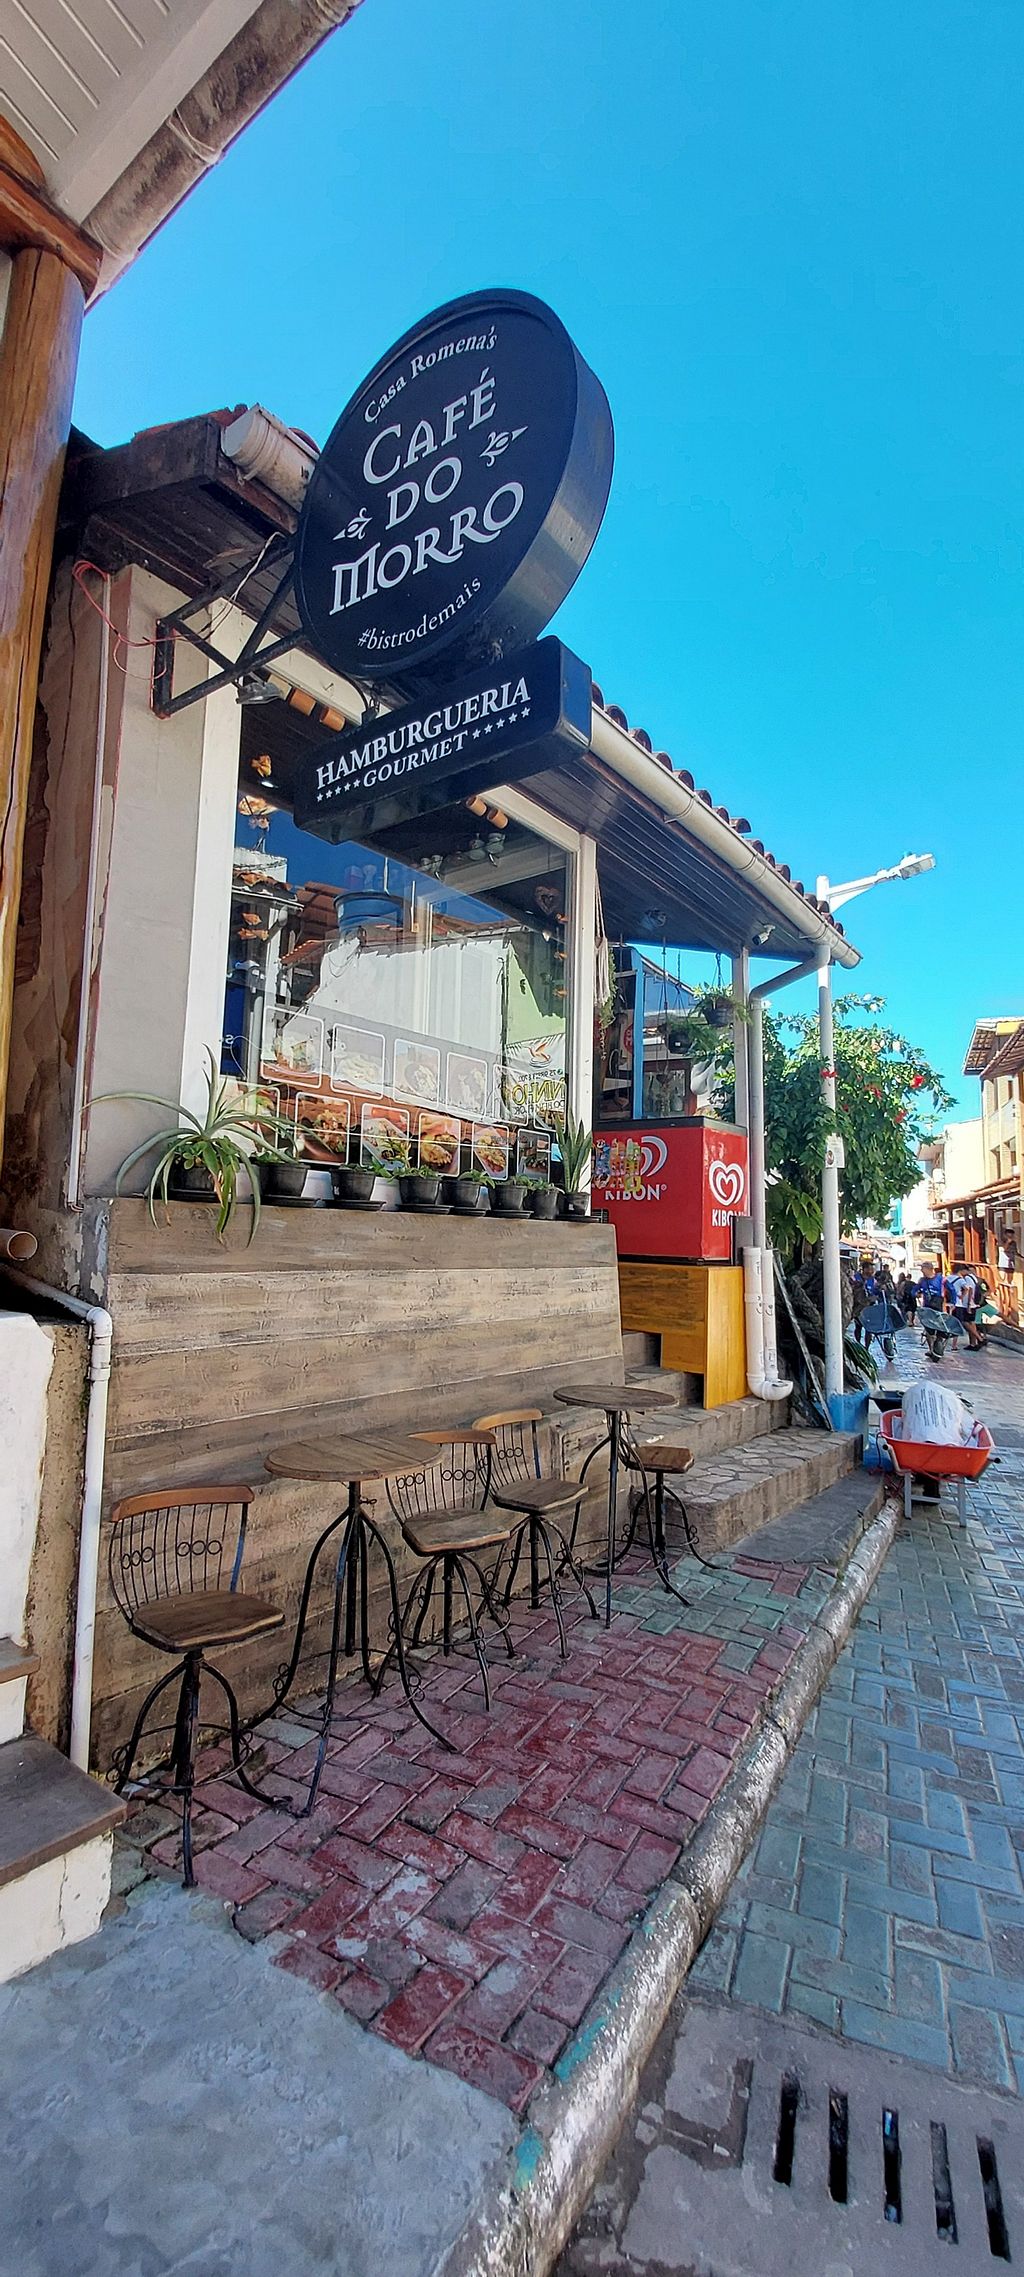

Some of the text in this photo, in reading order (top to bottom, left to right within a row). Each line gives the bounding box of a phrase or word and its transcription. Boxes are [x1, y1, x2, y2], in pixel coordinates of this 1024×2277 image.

[363, 325, 497, 424] Casa Romena's
[363, 367, 497, 484] CAFÉ
[385, 457, 462, 530] DO
[329, 482, 524, 615] MORRO
[357, 576, 482, 650] #bistrodemais
[316, 677, 531, 789] HAMBURGUERIA
[363, 730, 469, 788] GOURMET
